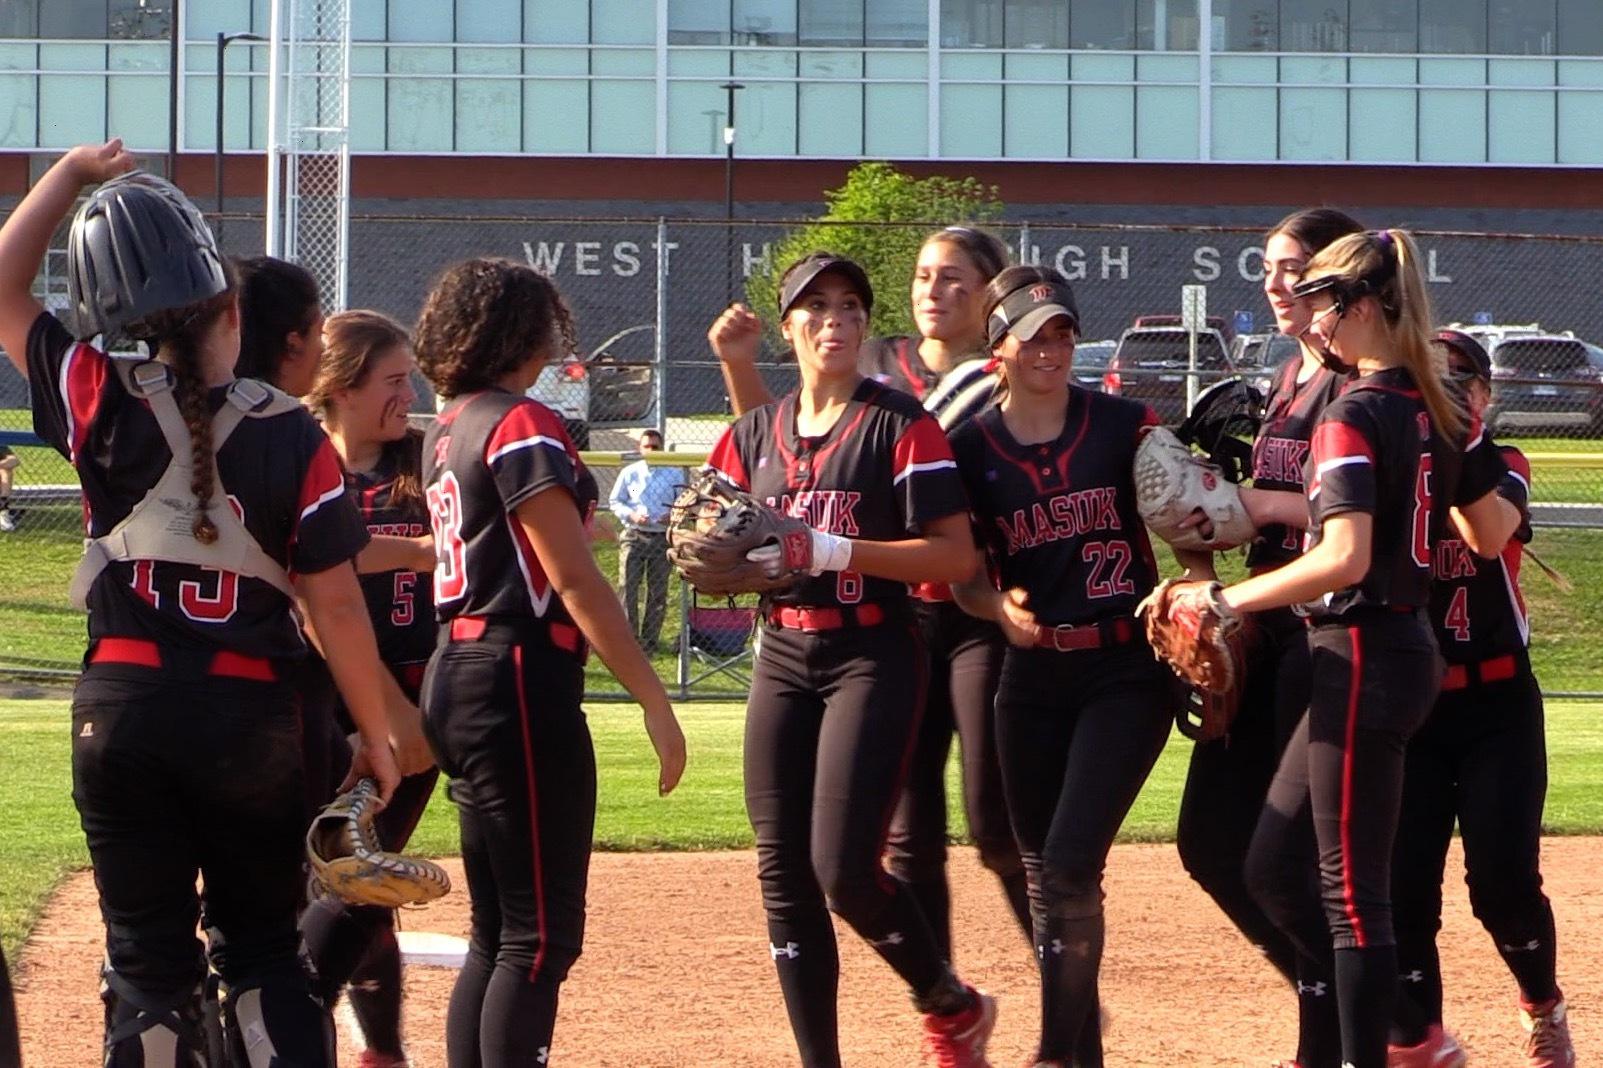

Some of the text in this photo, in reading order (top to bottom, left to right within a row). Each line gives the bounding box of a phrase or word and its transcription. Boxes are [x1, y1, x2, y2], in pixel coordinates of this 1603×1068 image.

[523, 241, 679, 277] WEST
[1007, 244, 1129, 280] IGH
[766, 490, 861, 536] SUK
[997, 487, 1121, 556] MASUK
[1082, 540, 1136, 599] 22
[391, 571, 417, 626] 5
[1445, 586, 1471, 642] 4
